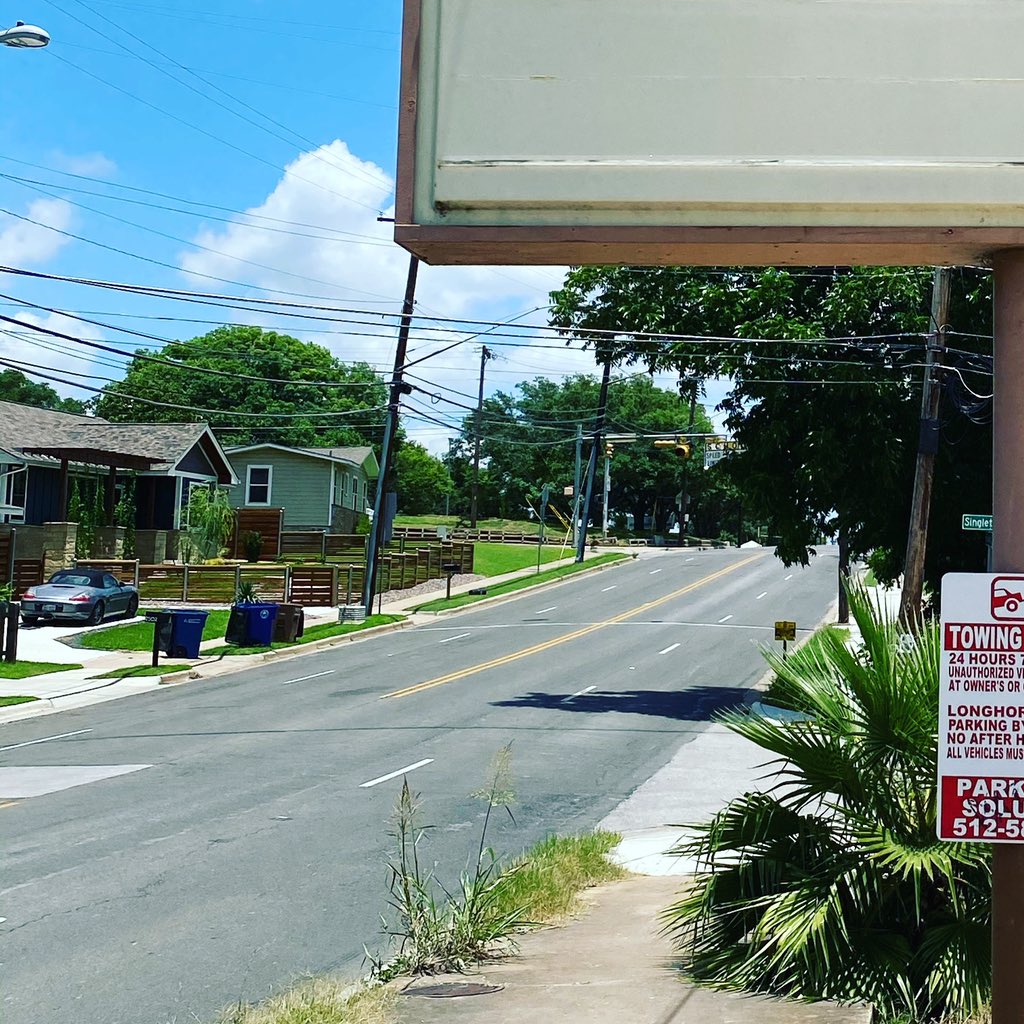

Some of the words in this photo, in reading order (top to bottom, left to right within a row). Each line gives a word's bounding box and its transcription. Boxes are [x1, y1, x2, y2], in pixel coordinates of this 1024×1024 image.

[949, 625, 1023, 650] TOWING
[949, 653, 965, 665] 24
[969, 653, 1016, 666] HOURS
[948, 666, 1014, 679] UNAUTHORIZED
[948, 680, 961, 692] AT
[963, 680, 1005, 693] OWNER'S
[1007, 681, 1021, 693] OR
[948, 719, 1008, 732] PARKING
[947, 732, 966, 745] NO
[969, 733, 1012, 746] AFTER
[946, 747, 962, 759] ALL
[964, 747, 1004, 760] VEHICLES
